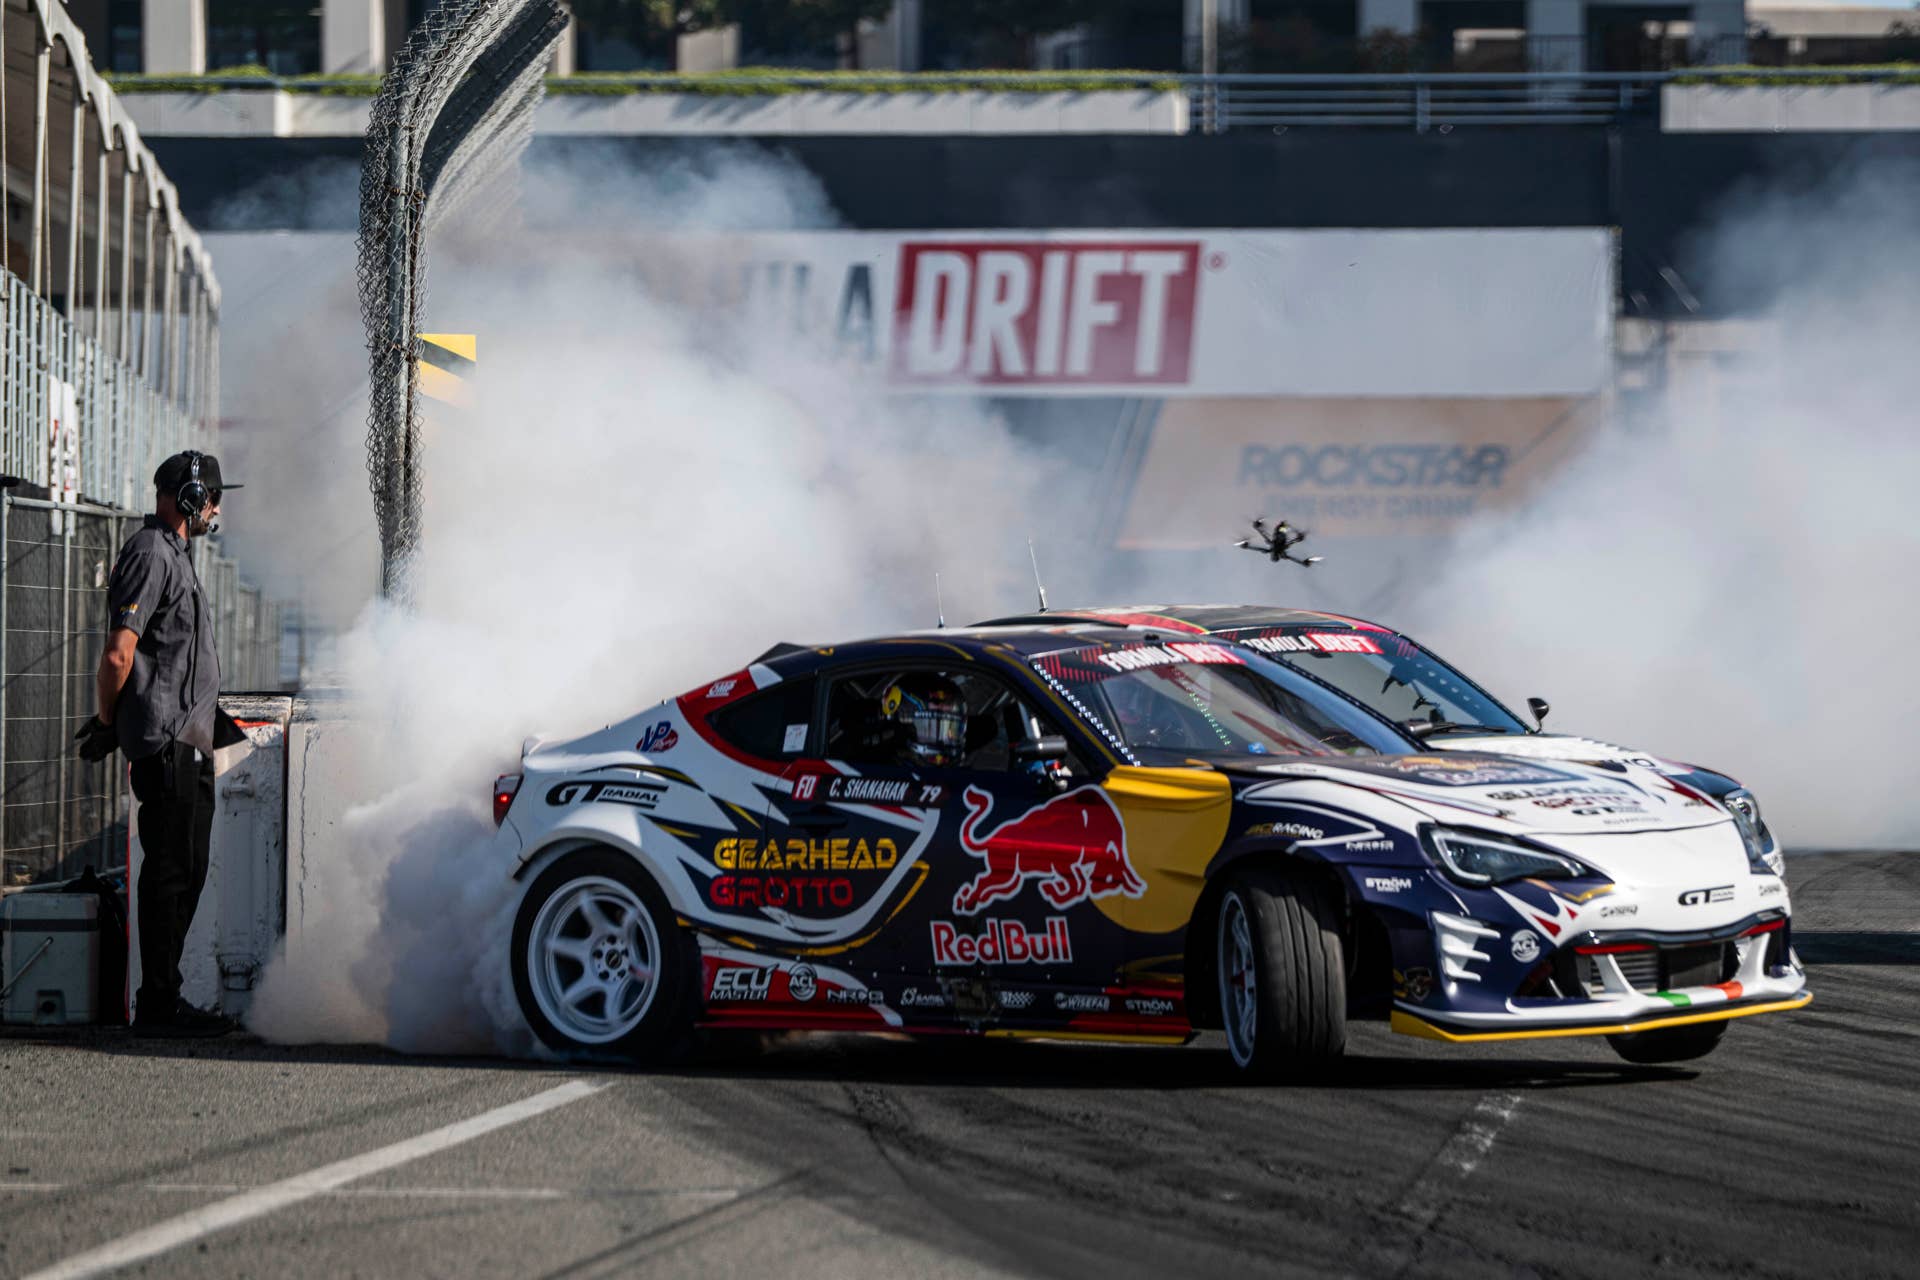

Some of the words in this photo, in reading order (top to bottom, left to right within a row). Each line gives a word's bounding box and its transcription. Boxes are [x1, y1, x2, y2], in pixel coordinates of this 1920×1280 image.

[905, 250, 1188, 376] DRIFT
[1238, 443, 1510, 486] ROCKSTAR
[1311, 634, 1377, 653] DRIFT
[1099, 645, 1190, 672] FORMULA
[640, 721, 671, 752] VP
[602, 788, 660, 803] RADIAL
[795, 775, 817, 799] FD
[829, 777, 840, 798] C.
[844, 779, 909, 801] SHANAHAN
[919, 785, 942, 802] 79
[1272, 823, 1324, 840] RACING
[714, 838, 898, 870] GEARHEAD
[710, 876, 854, 908] GROTTO
[931, 919, 1000, 966] Red
[1000, 916, 1072, 965] Bull
[1512, 939, 1539, 952] ACL
[713, 963, 780, 991] ECU
[789, 974, 814, 988] ACL
[710, 989, 768, 1000] MASTER
